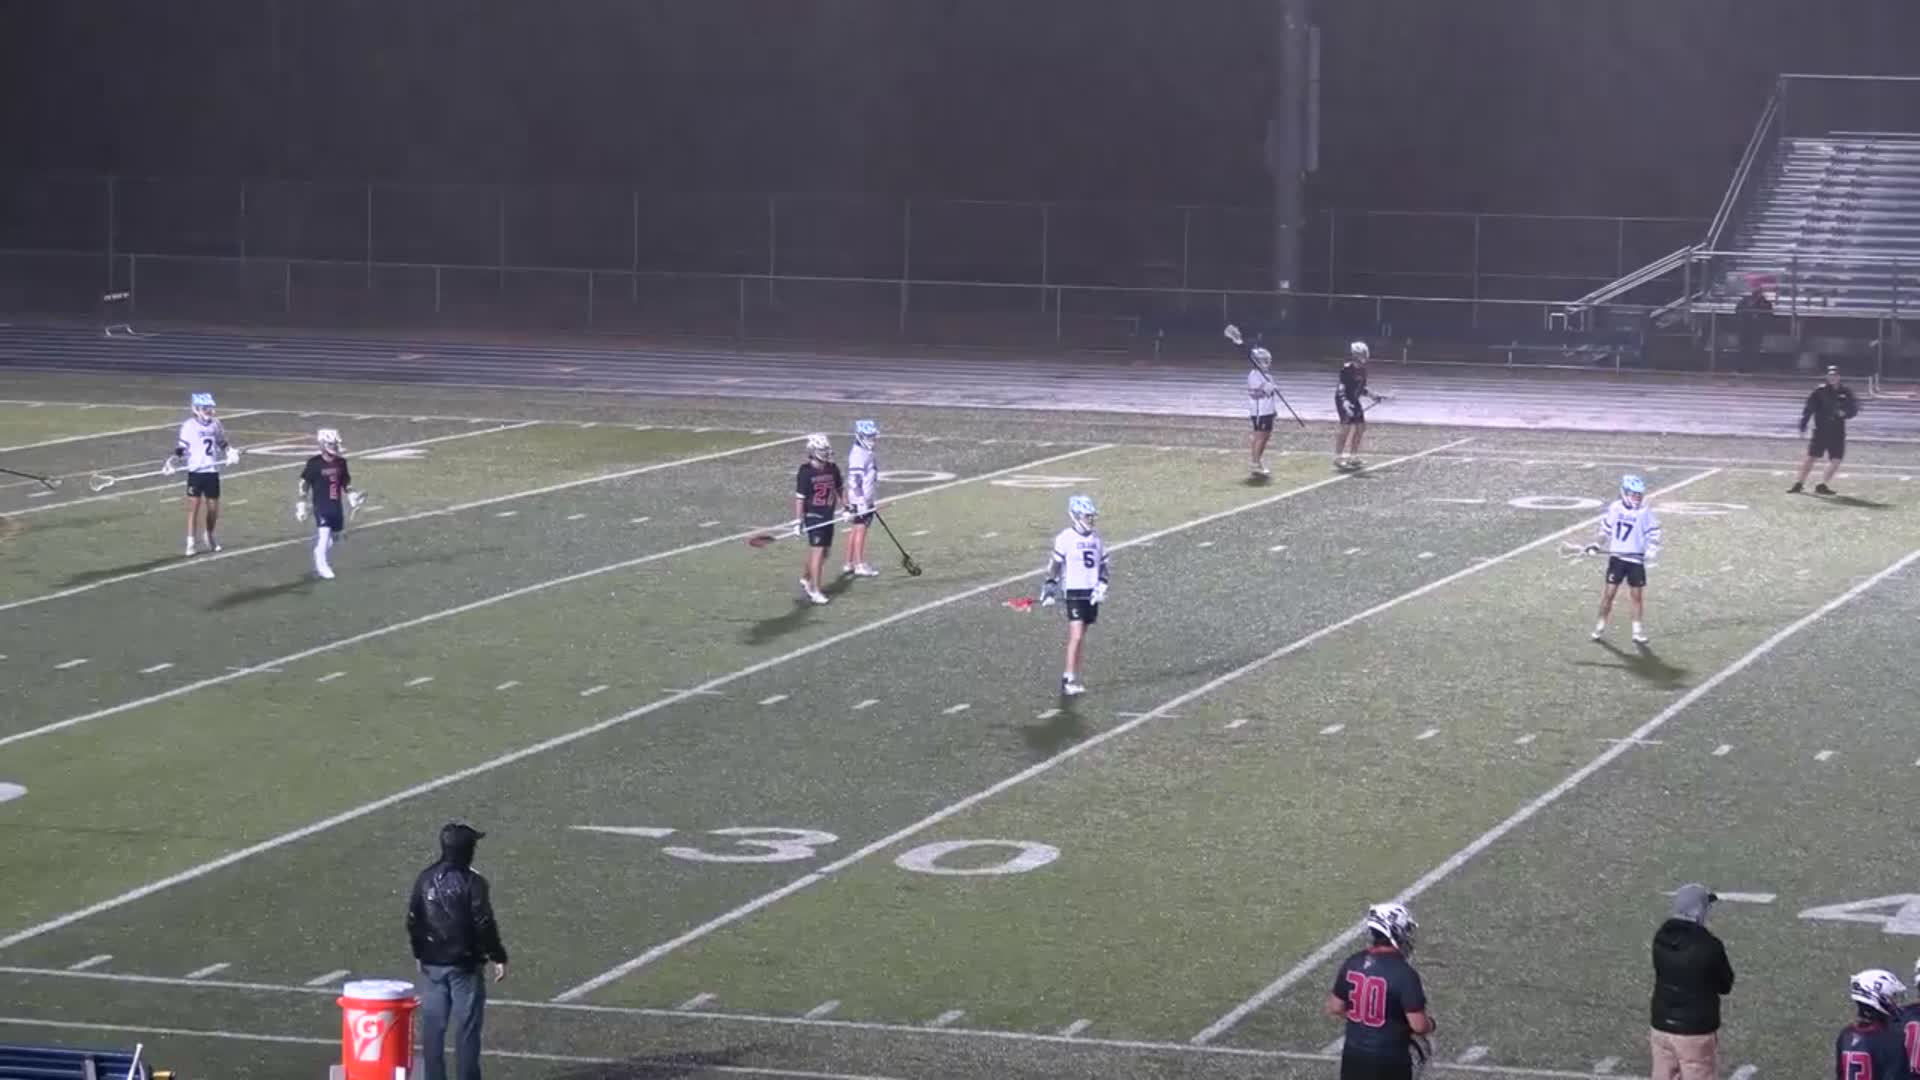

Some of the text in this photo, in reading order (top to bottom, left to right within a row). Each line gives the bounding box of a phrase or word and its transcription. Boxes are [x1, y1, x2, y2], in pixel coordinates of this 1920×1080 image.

[203, 438, 213, 456] 2
[1616, 521, 1634, 542] 17
[1083, 551, 1095, 569] 5
[1346, 970, 1387, 1028] 30
